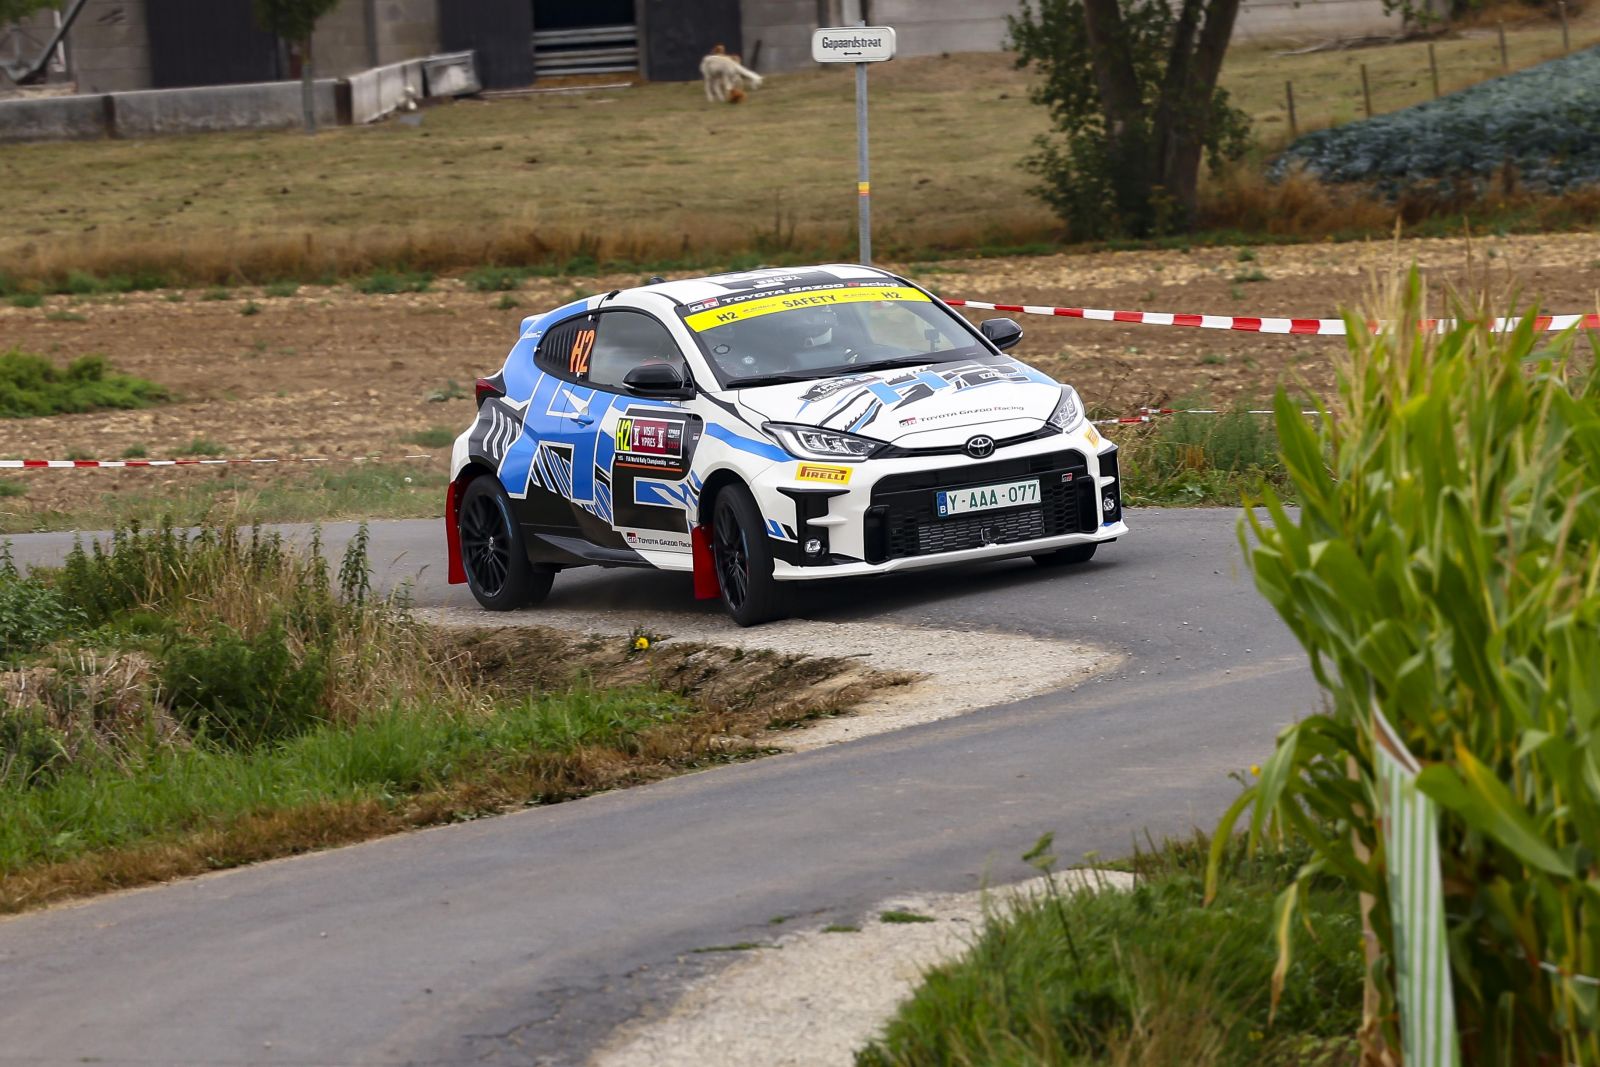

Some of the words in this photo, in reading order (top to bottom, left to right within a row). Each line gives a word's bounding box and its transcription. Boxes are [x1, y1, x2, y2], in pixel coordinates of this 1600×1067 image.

[822, 36, 881, 50] Gapaardstraat
[722, 289, 785, 303] TOYOTA
[789, 283, 844, 293] GAZOO
[716, 311, 739, 322] H2
[782, 295, 837, 308] SAFETY
[881, 291, 902, 299] H2
[570, 330, 595, 373] H2
[919, 412, 957, 422] TOYOTA
[960, 407, 992, 415] GAZOO
[616, 420, 632, 451] H2
[643, 426, 656, 436] VISIT
[641, 437, 656, 448] YPRES
[800, 466, 847, 481] PIRELLI
[940, 505, 947, 514] B
[638, 537, 659, 545] TOYOTA
[659, 539, 679, 547] GAZOO
